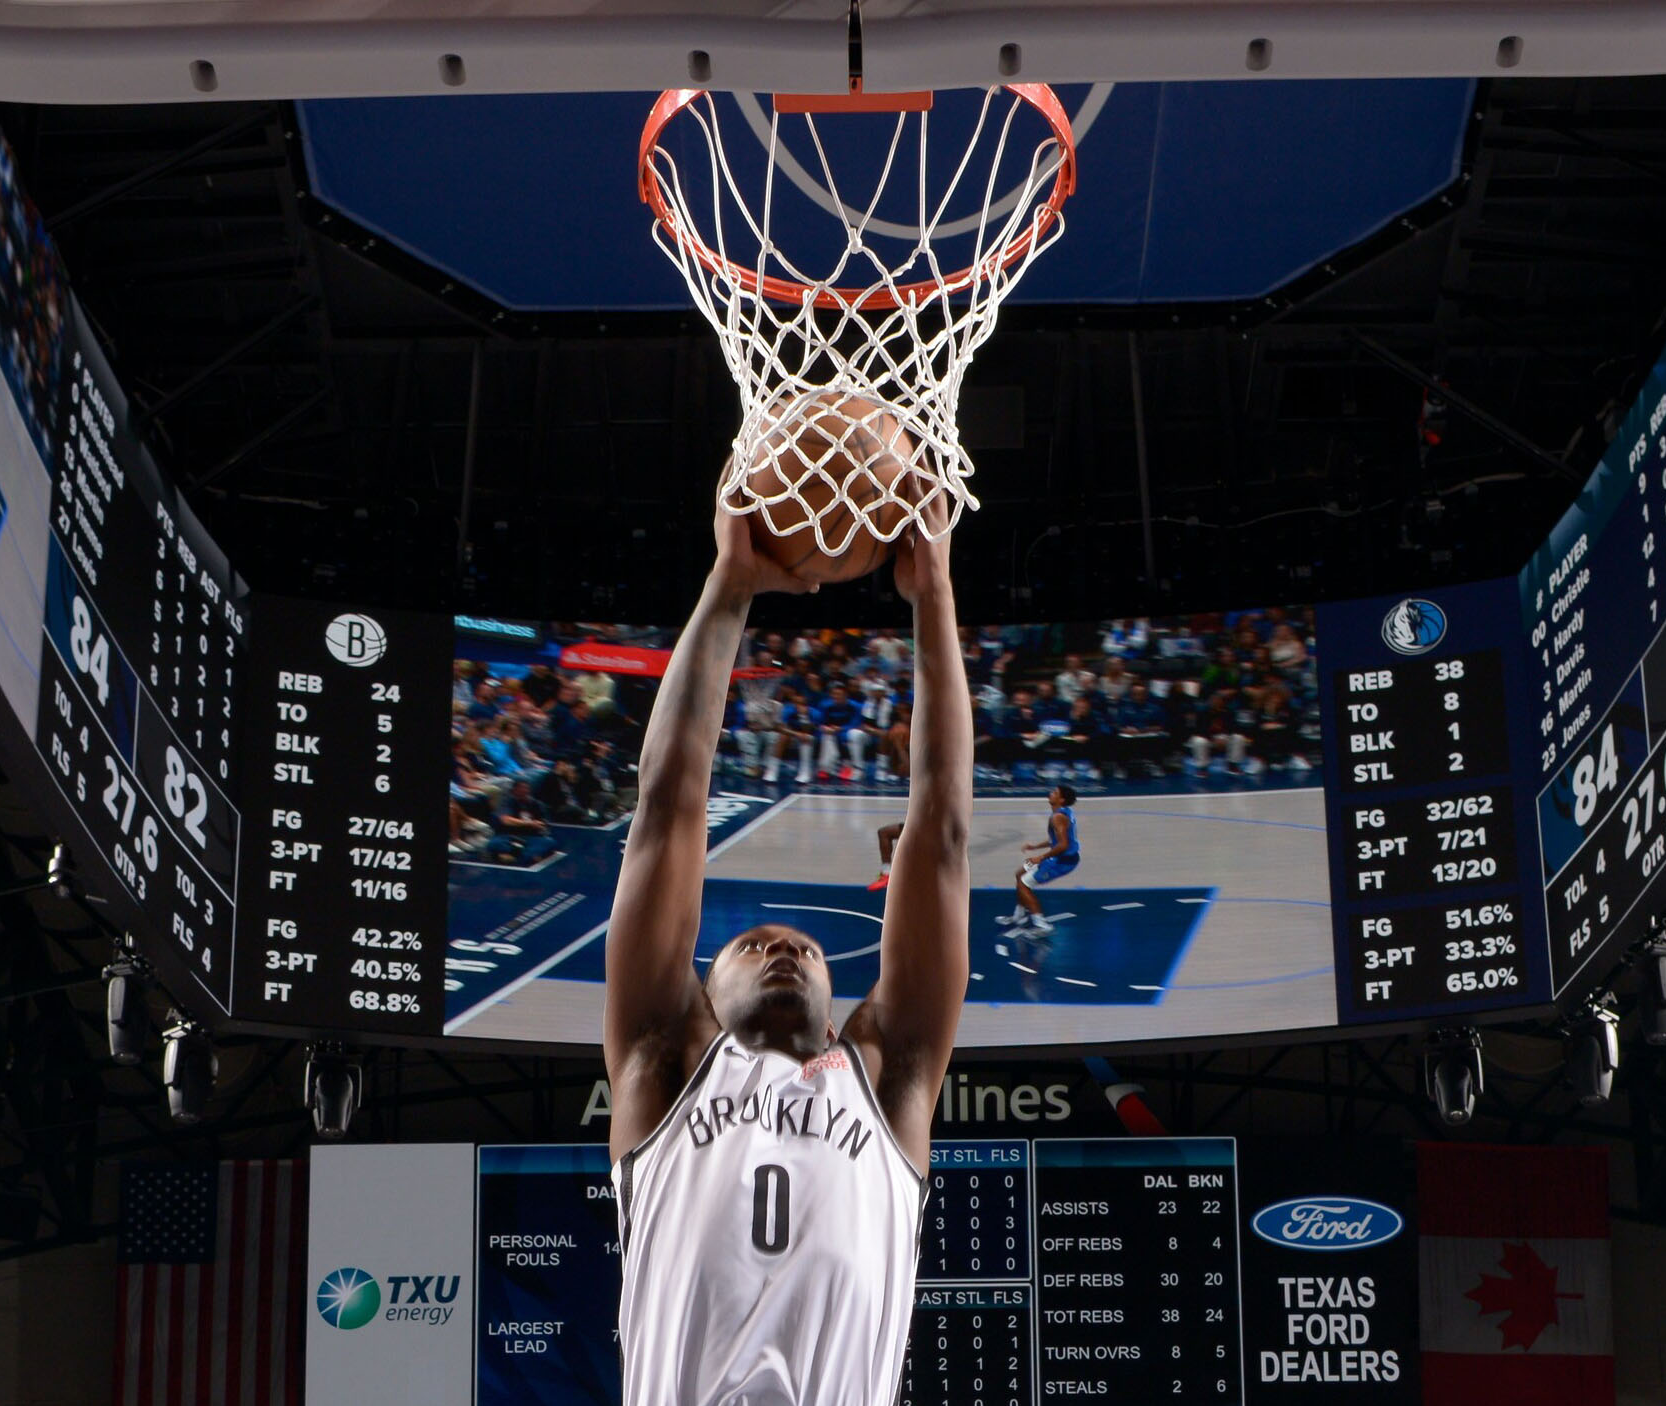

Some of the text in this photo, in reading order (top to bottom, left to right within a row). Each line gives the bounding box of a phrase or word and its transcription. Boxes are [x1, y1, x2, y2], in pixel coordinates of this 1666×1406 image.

[1549, 534, 1588, 594] PLAYER
[1552, 569, 1589, 622] Christie
[1554, 609, 1584, 654] Hardy
[71, 596, 109, 706] 84
[1556, 644, 1585, 685] Davis
[279, 672, 400, 702] REB 24
[1349, 661, 1464, 691] REB 38
[1348, 692, 1459, 722] TO 8
[1559, 668, 1592, 716] Martin
[54, 680, 88, 752] TOL 4
[277, 702, 392, 732] TO 5
[1562, 704, 1591, 748] Jones
[276, 733, 391, 762] BLK 2
[1351, 722, 1459, 752] BLK 1
[52, 733, 86, 801] FLS 5
[274, 763, 390, 792] STL 6
[1354, 753, 1463, 782] STL 2
[1573, 723, 1618, 826] 84
[164, 746, 207, 849] 82
[1356, 796, 1493, 829] FG 32/62
[104, 755, 158, 872] 27.6
[273, 809, 414, 839] FG 27/64
[271, 840, 411, 870] 3-PT 17/42
[1358, 827, 1486, 859] 3-PT 7/21
[270, 871, 407, 901] FT 11/16
[1359, 858, 1496, 890] FT 13/20
[1564, 849, 1606, 910] TOL 4
[176, 865, 214, 925] TOL 3
[268, 919, 422, 950] FG 42.2%
[1363, 904, 1513, 938] FG 51.6%
[1569, 896, 1609, 956] FLS 5
[173, 913, 211, 972] FLS 4
[1365, 935, 1515, 969] 3-PT 33.3%
[266, 951, 421, 981] 3-PT 40.5%
[265, 982, 420, 1013] FT 68.8%
[1366, 967, 1518, 1000] FT 65.0%
[943, 1074, 1072, 1123] lines
[686, 1086, 875, 1162] BROOKLYN
[1144, 1175, 1223, 1188] DAL BKN
[752, 1165, 790, 1256] 0
[1041, 1201, 1220, 1215] ASSISTS 23 22
[1282, 1203, 1374, 1241] Ford
[490, 1235, 577, 1248] PERSONAL
[1043, 1237, 1221, 1251] OFF REBS 8 4
[507, 1253, 560, 1266] FOULS
[386, 1275, 460, 1304] TXU
[1044, 1273, 1222, 1287] DEF REBS 30 20
[1278, 1277, 1375, 1308] TEXAS
[385, 1306, 453, 1325] energy
[489, 1322, 564, 1335] LARGEST
[1044, 1309, 1223, 1323] TOT REBS 38 24
[1288, 1314, 1369, 1345] FORD
[505, 1340, 547, 1353] LEAD
[1045, 1345, 1225, 1359] TURN OVRS 8 5
[1261, 1350, 1399, 1382] DEALERS
[1046, 1380, 1226, 1394] STEALS 2 6
